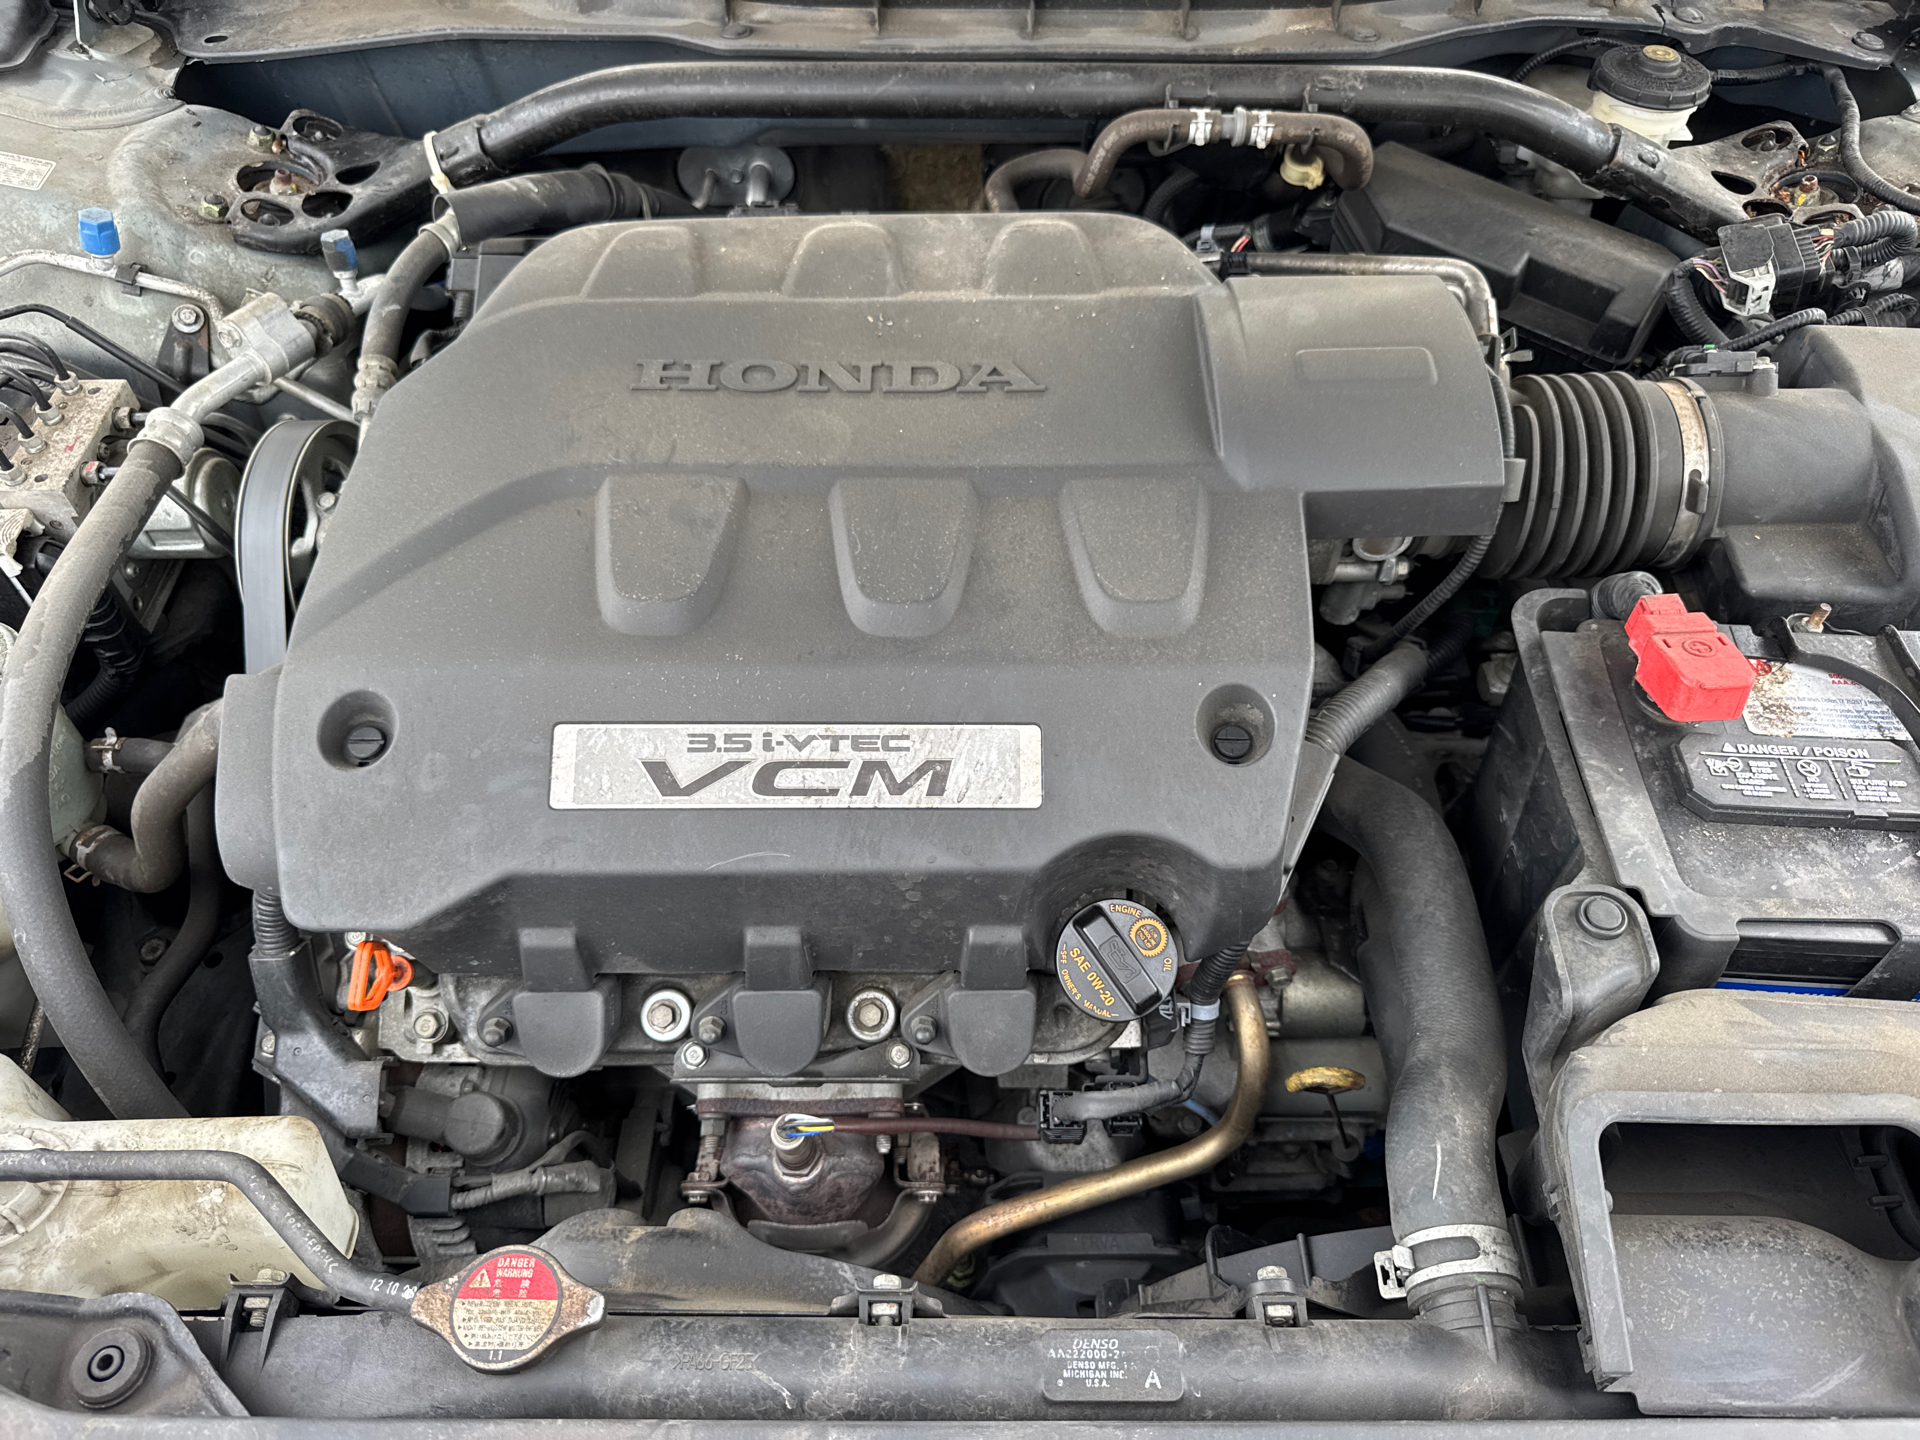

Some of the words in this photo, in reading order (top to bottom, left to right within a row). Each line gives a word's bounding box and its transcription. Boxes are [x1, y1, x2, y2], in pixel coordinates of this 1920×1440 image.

[630, 360, 1047, 394] HONDA
[686, 732, 753, 753] 3.5
[762, 731, 911, 753] i-VTEC
[1737, 743, 1800, 756] DANGER
[1813, 747, 1870, 758] POISON
[637, 758, 956, 798] VCM
[1110, 904, 1142, 918] ENGINE
[1163, 957, 1173, 972] OIL
[1069, 947, 1092, 973] SAE
[1086, 972, 1115, 1006] 0W-20
[497, 1257, 536, 1268] DANGER
[369, 1278, 384, 1292] 12
[386, 1282, 399, 1296] 10
[1072, 1338, 1119, 1350] DENSO
[489, 1349, 502, 1360] 1.1
[1067, 1361, 1096, 1370] DENSO
[1098, 1361, 1120, 1370] MFG.
[1063, 1369, 1107, 1379] MICHIGAN
[1110, 1370, 1128, 1379] INC.
[1145, 1370, 1162, 1390] A
[1085, 1379, 1110, 1388] U.S.A.
